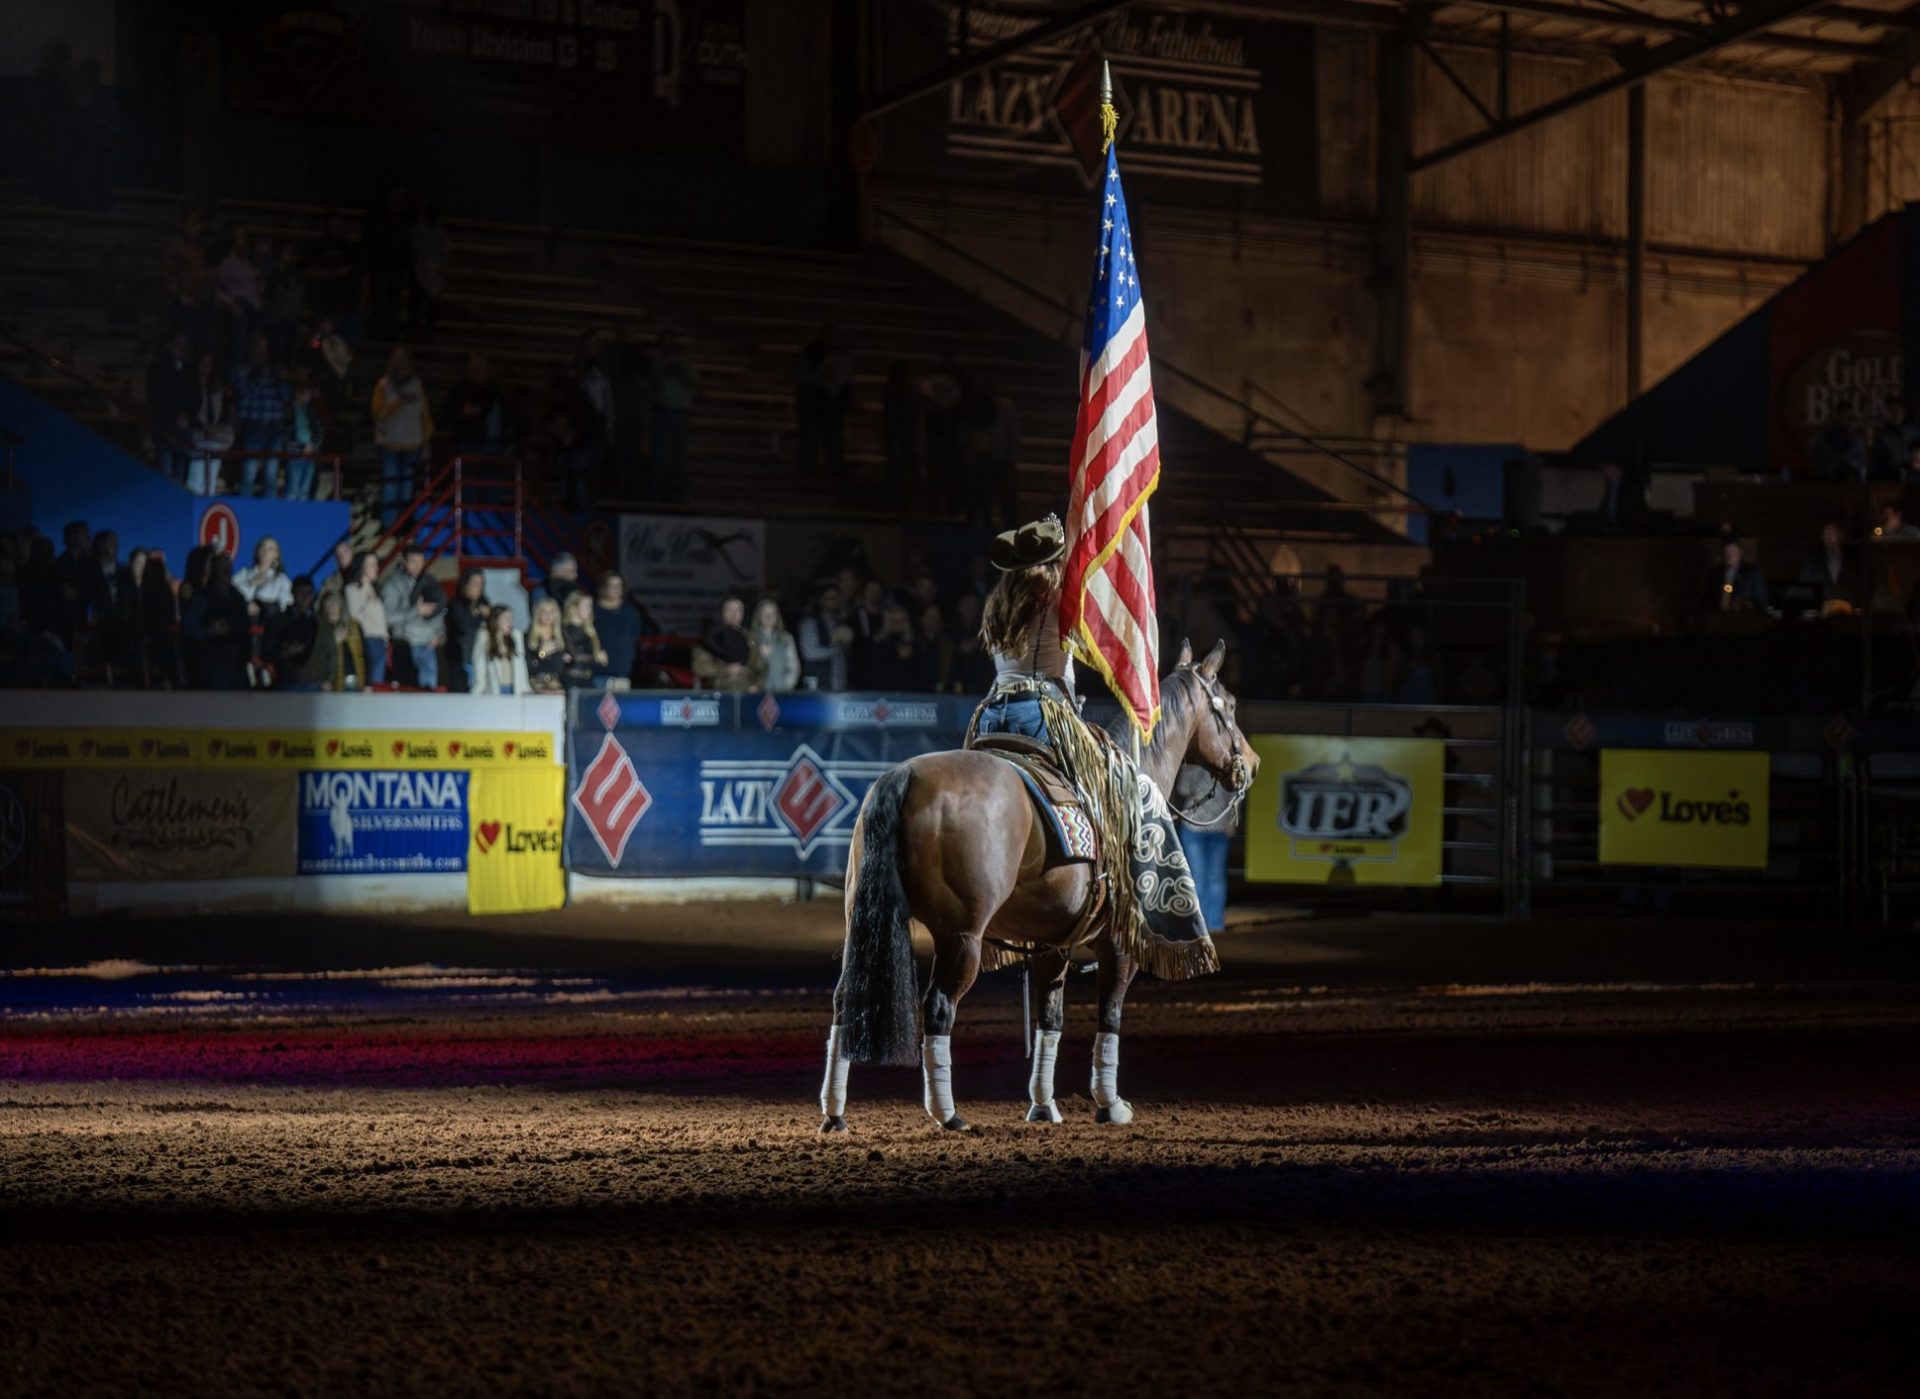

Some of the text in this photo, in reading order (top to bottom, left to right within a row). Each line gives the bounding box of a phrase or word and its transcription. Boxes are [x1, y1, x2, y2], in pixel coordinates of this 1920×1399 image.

[951, 66, 1262, 155] LAZY ARENA
[892, 704, 938, 721] ARENA
[111, 773, 250, 827] Cattlemen's
[304, 771, 463, 809] MONTANA
[700, 779, 773, 826] LAZY
[1660, 788, 1751, 825] Love's
[352, 814, 465, 832] SILVERSMITHS
[505, 818, 561, 852] Love's
